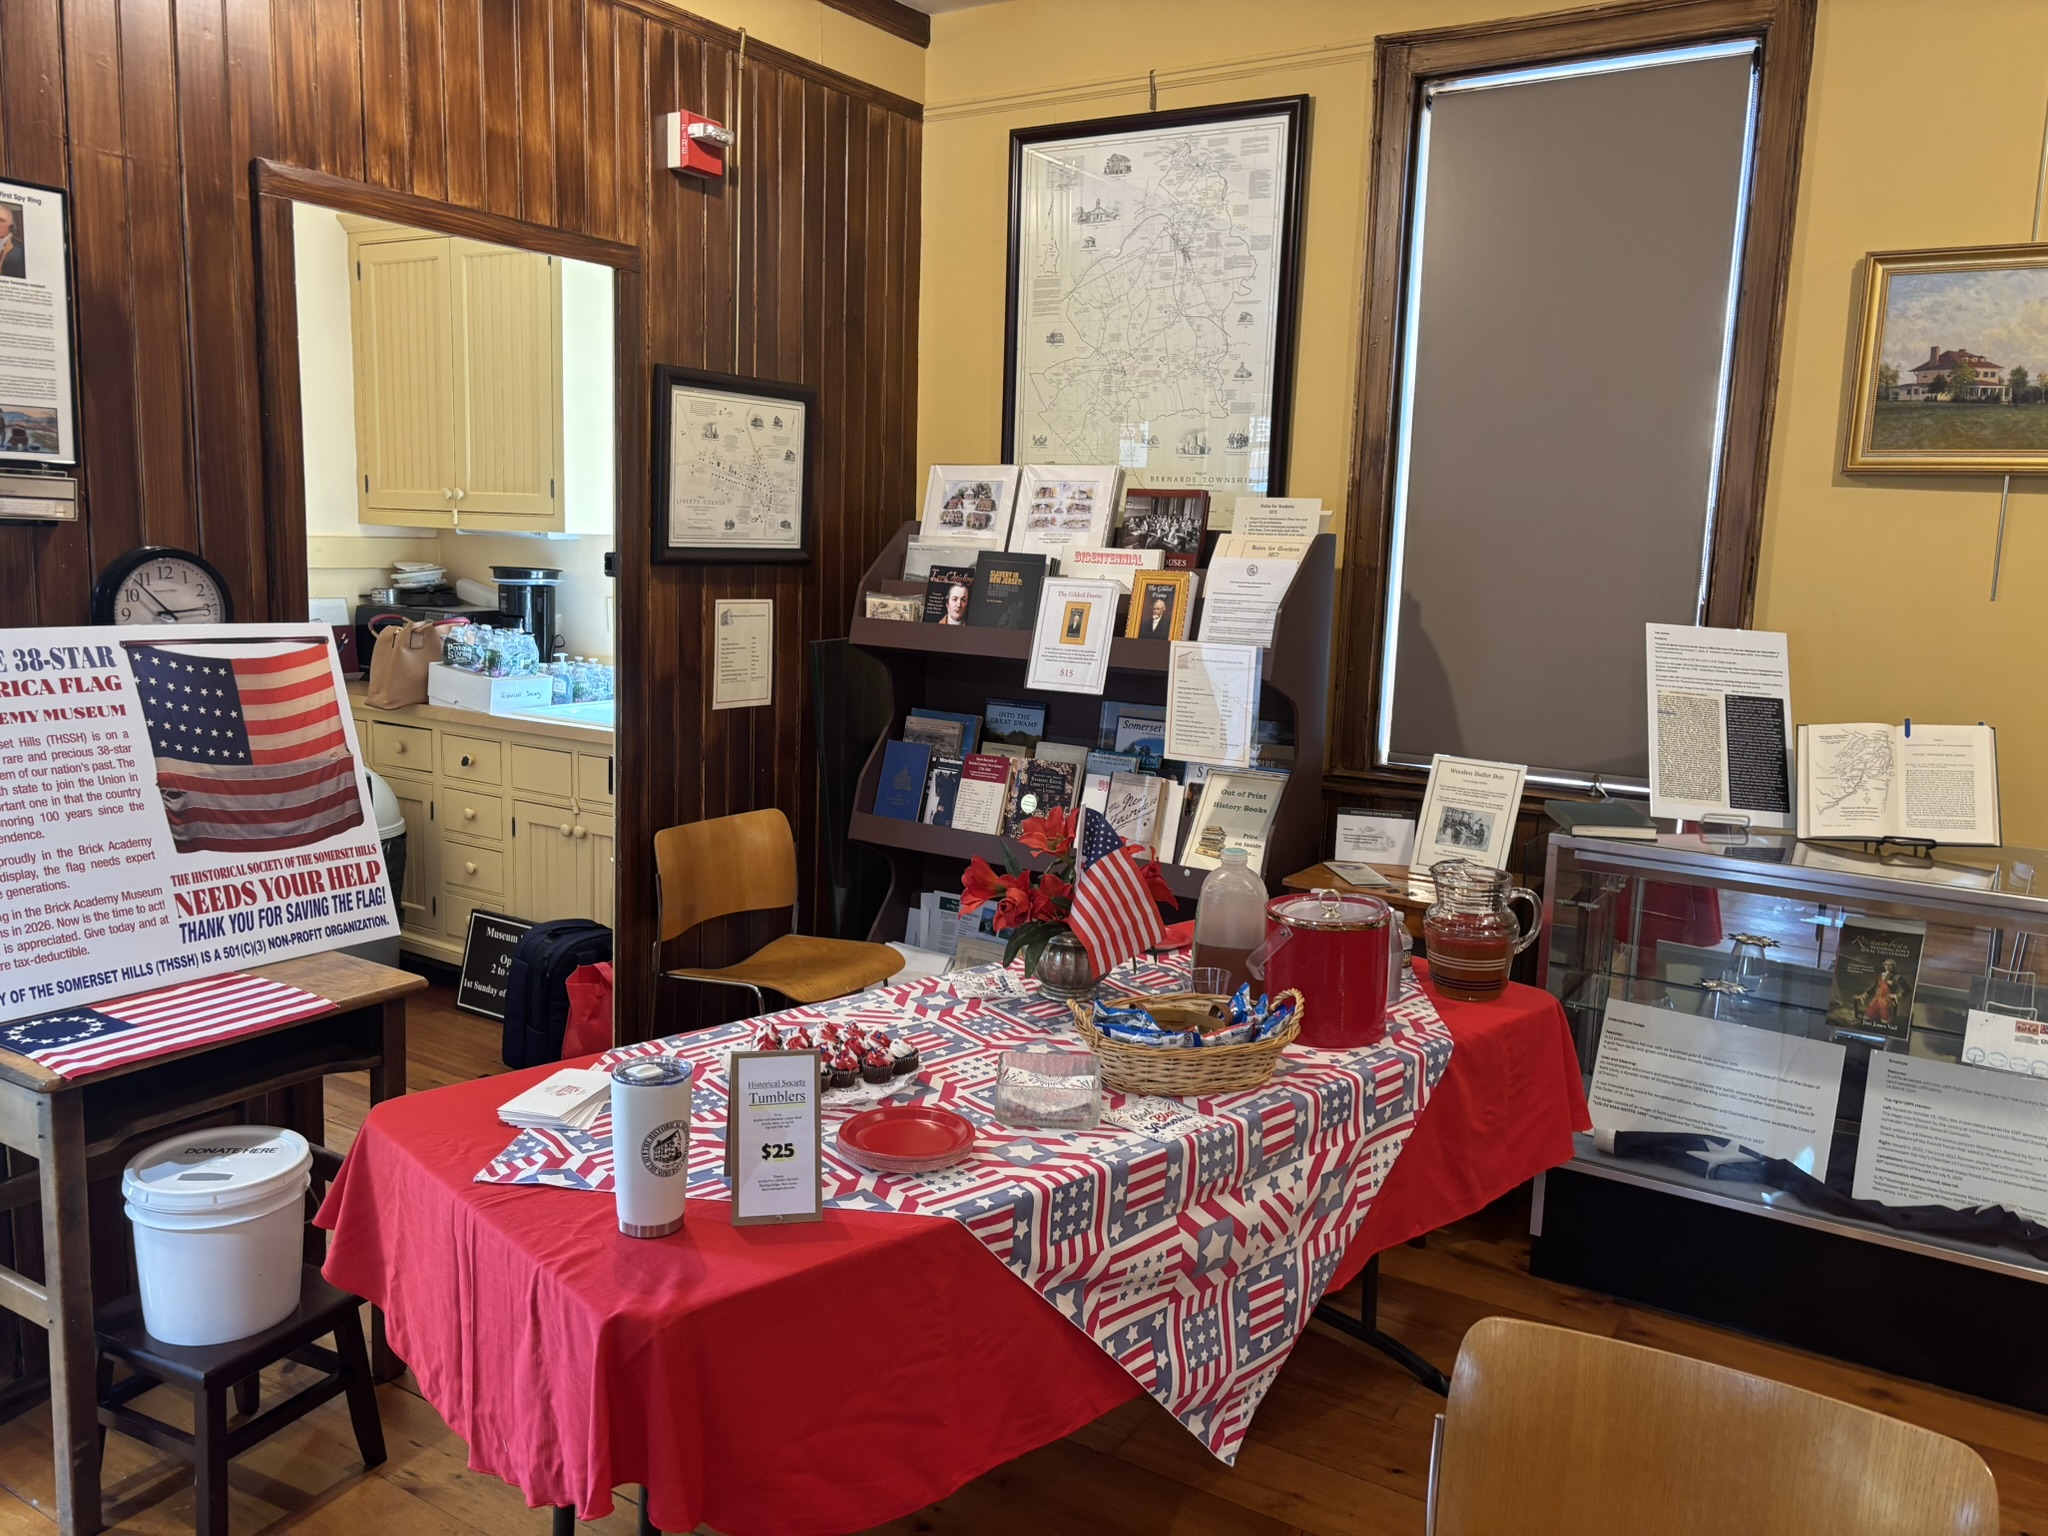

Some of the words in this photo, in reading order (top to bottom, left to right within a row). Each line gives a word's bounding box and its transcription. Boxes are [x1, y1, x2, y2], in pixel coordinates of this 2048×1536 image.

[14, 194, 25, 202] Spy
[27, 196, 42, 206] Ring
[1074, 551, 1144, 566] BICENTENNIAL
[140, 572, 151, 586] 11
[158, 566, 173, 580] 12
[990, 570, 1012, 578] SLAVERY
[989, 576, 1002, 584] NEW
[1002, 578, 1022, 586] JERSEY:
[125, 588, 139, 602] 10
[196, 584, 205, 597] 2
[122, 608, 131, 621] 9
[12, 646, 117, 671] 38-STAR
[1060, 668, 1074, 678] $15
[58, 675, 122, 692] FLAG
[42, 705, 126, 720] MUSEUM
[1014, 720, 1038, 728] SWAMP
[1123, 720, 1162, 732] Somerset
[18, 737, 41, 746] Hills
[46, 733, 87, 746] (THSSH)
[91, 732, 101, 740] is
[1, 755, 23, 763] rare
[27, 751, 47, 761] and
[50, 748, 93, 761] precious
[96, 745, 131, 754] 38-star
[18, 768, 28, 777] of
[31, 768, 48, 776] our
[50, 763, 90, 774] nation's
[91, 760, 116, 772] past.
[116, 759, 135, 767] The
[1450, 768, 1472, 776] Wooden
[12, 784, 38, 793] state
[41, 782, 52, 790] to
[55, 779, 74, 791] join
[77, 778, 94, 786] the
[97, 775, 126, 784] Union
[128, 773, 138, 781] in
[28, 799, 48, 807] one
[50, 796, 61, 804] in
[63, 793, 84, 803] that
[85, 792, 102, 800] the
[105, 788, 141, 798] country
[1247, 792, 1266, 800] Print
[39, 811, 59, 821] 100
[64, 809, 93, 820] years
[97, 805, 124, 814] since
[128, 802, 144, 810] the
[1213, 802, 1240, 811] History
[1244, 806, 1267, 814] Books
[41, 851, 51, 859] in
[55, 848, 73, 857] the
[77, 843, 104, 854] Brick
[108, 838, 151, 850] Academy
[42, 866, 60, 875] the
[65, 863, 85, 871] flag
[90, 856, 120, 868] needs
[125, 851, 155, 863] expert
[169, 873, 190, 886] THE
[190, 865, 247, 882] HISTORICAL
[246, 859, 283, 873] SOCIETY
[283, 857, 295, 867] OF
[295, 854, 313, 865] THE
[312, 847, 354, 863] SOMERSET
[354, 844, 377, 855] HILLS
[5, 881, 69, 899] generations.
[173, 881, 257, 917] NEEDS
[257, 870, 325, 901] YOUR
[325, 861, 380, 889] HELP
[178, 916, 226, 943] THANK
[228, 911, 254, 933] YOU
[257, 906, 283, 927] FOR
[285, 897, 329, 922] SAVING
[330, 892, 353, 913] THE
[355, 886, 386, 908] FLAG!
[486, 926, 518, 944] Museum
[9, 988, 25, 1002] OF
[28, 983, 54, 998] THE
[56, 970, 118, 993] SOMERSET
[120, 963, 153, 979] HILLS
[155, 954, 199, 975] (THSSH)
[200, 951, 211, 962] IS
[214, 949, 221, 960] A
[222, 940, 266, 958] 501(C)(3)
[267, 928, 322, 948] NON-PROFIT
[324, 915, 389, 936] ORGANIZATION.
[491, 964, 496, 974] 2
[498, 966, 505, 976] to
[464, 978, 472, 988] 1st
[474, 981, 498, 996] Sunday
[499, 989, 507, 998] of
[748, 1080, 780, 1088] Historical
[782, 1079, 806, 1087] Society
[748, 1091, 806, 1104] Tumblers
[762, 1142, 794, 1160] $25
